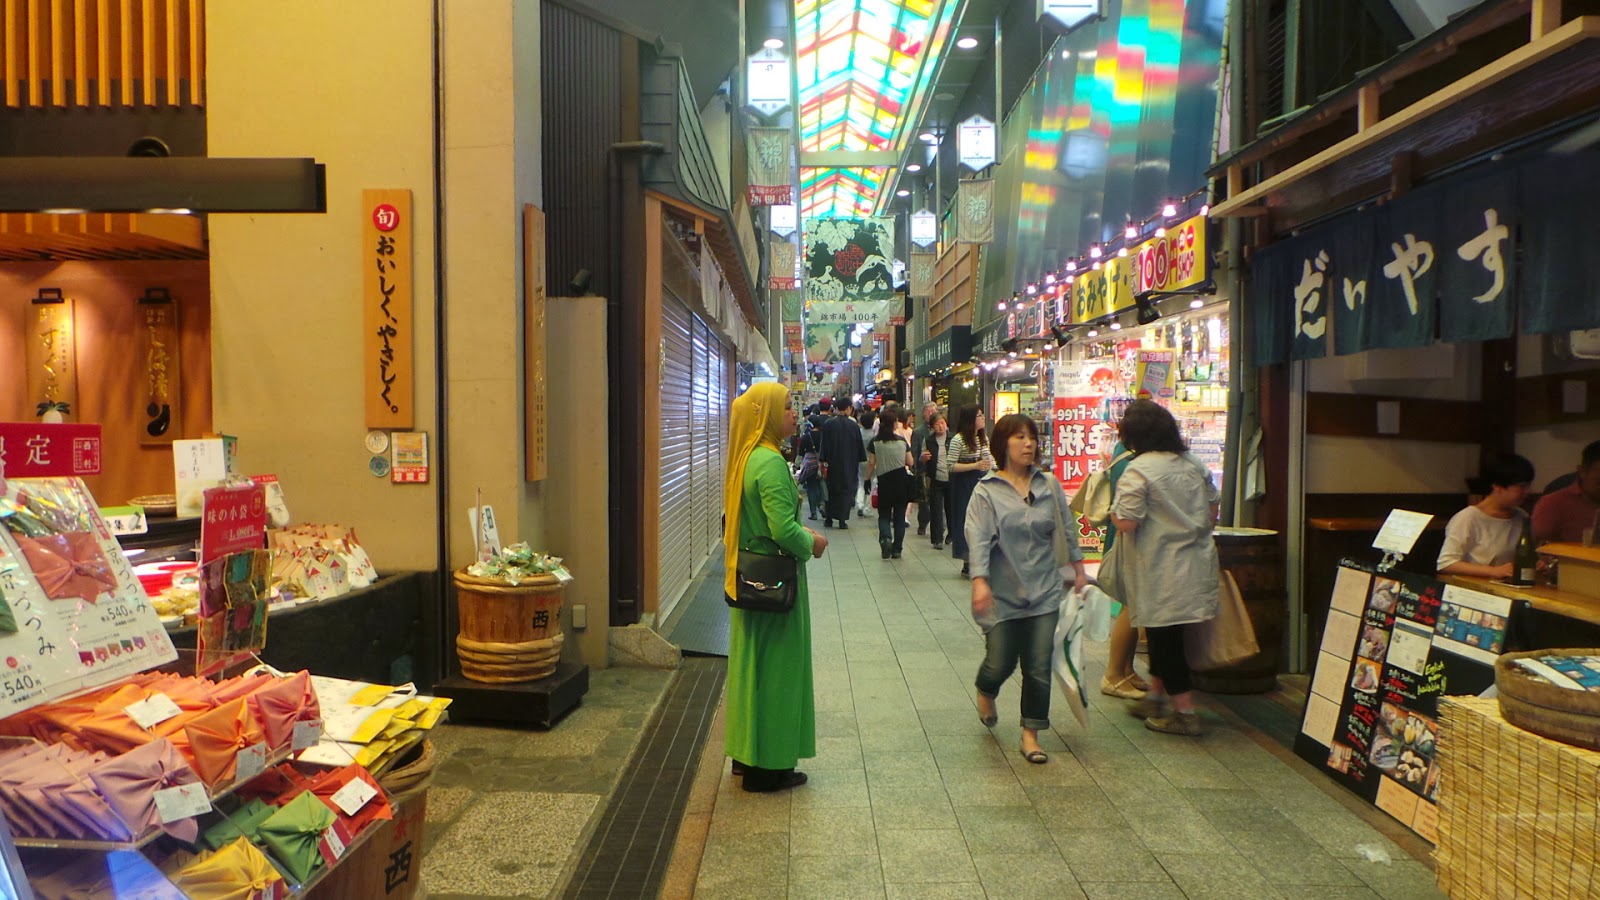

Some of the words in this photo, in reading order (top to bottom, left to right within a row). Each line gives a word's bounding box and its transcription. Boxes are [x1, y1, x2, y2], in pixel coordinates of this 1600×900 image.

[377, 208, 394, 227] 旬
[1178, 250, 1194, 281] SHOP
[376, 235, 399, 414] おいしく、やさしく。
[820, 312, 847, 321] 錦市場
[852, 312, 879, 321] 400年
[207, 504, 248, 524] 味の小袋
[384, 840, 412, 895] 西
